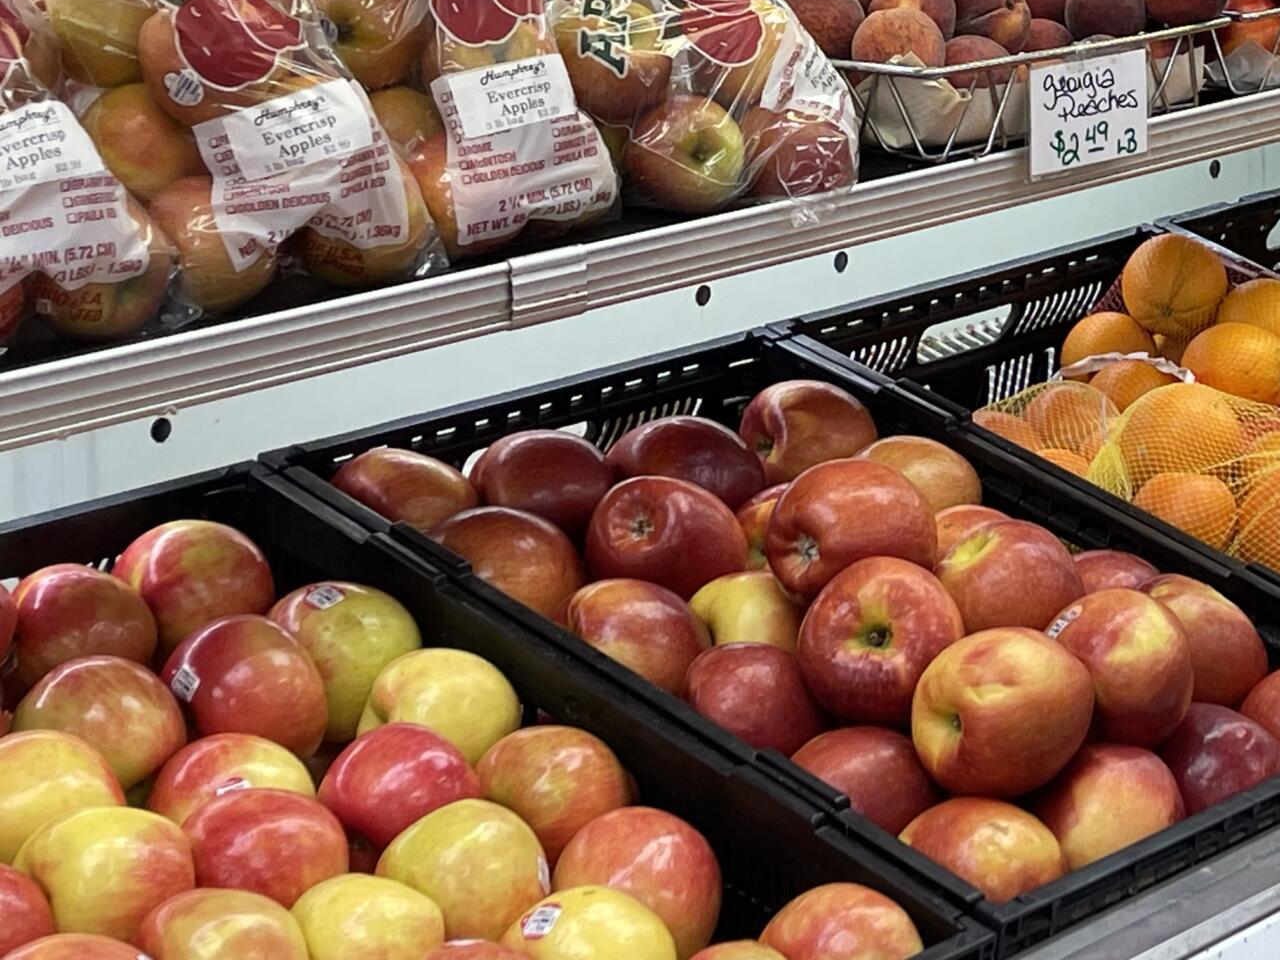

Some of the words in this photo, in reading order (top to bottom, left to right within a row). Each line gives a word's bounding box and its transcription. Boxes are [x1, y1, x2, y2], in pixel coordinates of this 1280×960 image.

[486, 81, 551, 105] Evercrisp
[501, 97, 545, 116] Apples
[0, 129, 65, 156] vercrisp
[262, 114, 337, 147] Evercrisp
[278, 132, 332, 158] Apples
[6, 146, 62, 171] Apples
[64, 244, 94, 266] (5.72
